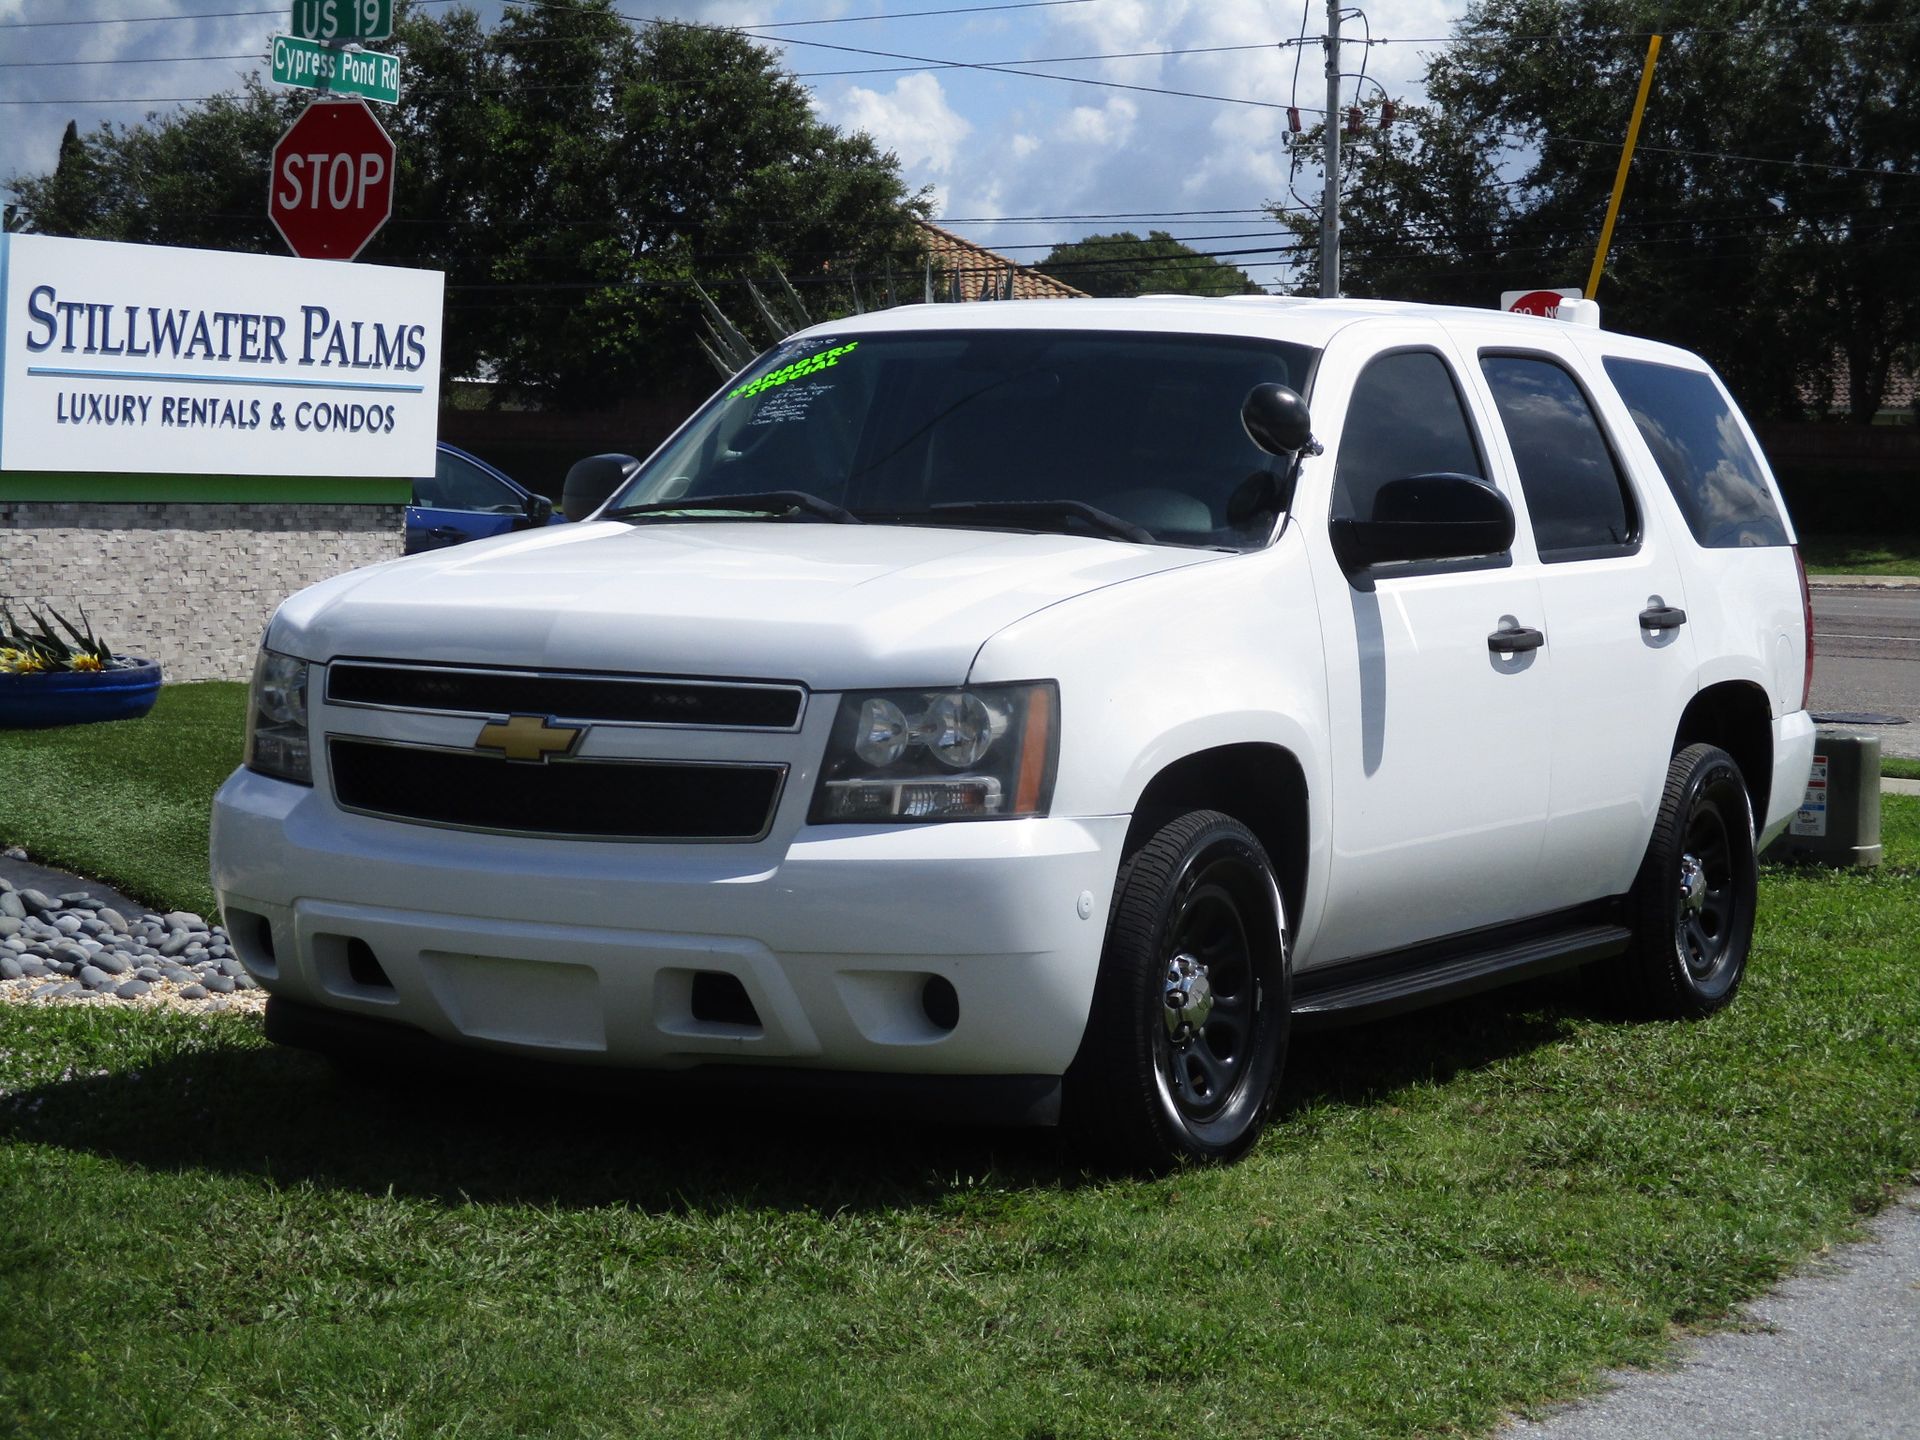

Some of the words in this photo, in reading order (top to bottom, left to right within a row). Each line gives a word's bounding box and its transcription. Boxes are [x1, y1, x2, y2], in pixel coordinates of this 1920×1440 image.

[302, 0, 338, 39] US
[353, 0, 380, 36] 19
[275, 39, 336, 80] Cypress
[342, 51, 376, 86] Pond
[381, 58, 397, 90] Rd
[279, 152, 385, 210] STOP
[26, 285, 288, 364] STILLWATER
[298, 305, 426, 371] PALMS
[725, 341, 859, 401] MANAGERS
[744, 356, 839, 399] SPECIAL
[57, 392, 152, 425] LUXURY
[161, 396, 261, 429] RENTALS
[270, 401, 286, 430] &
[295, 401, 395, 433] CONDOS
